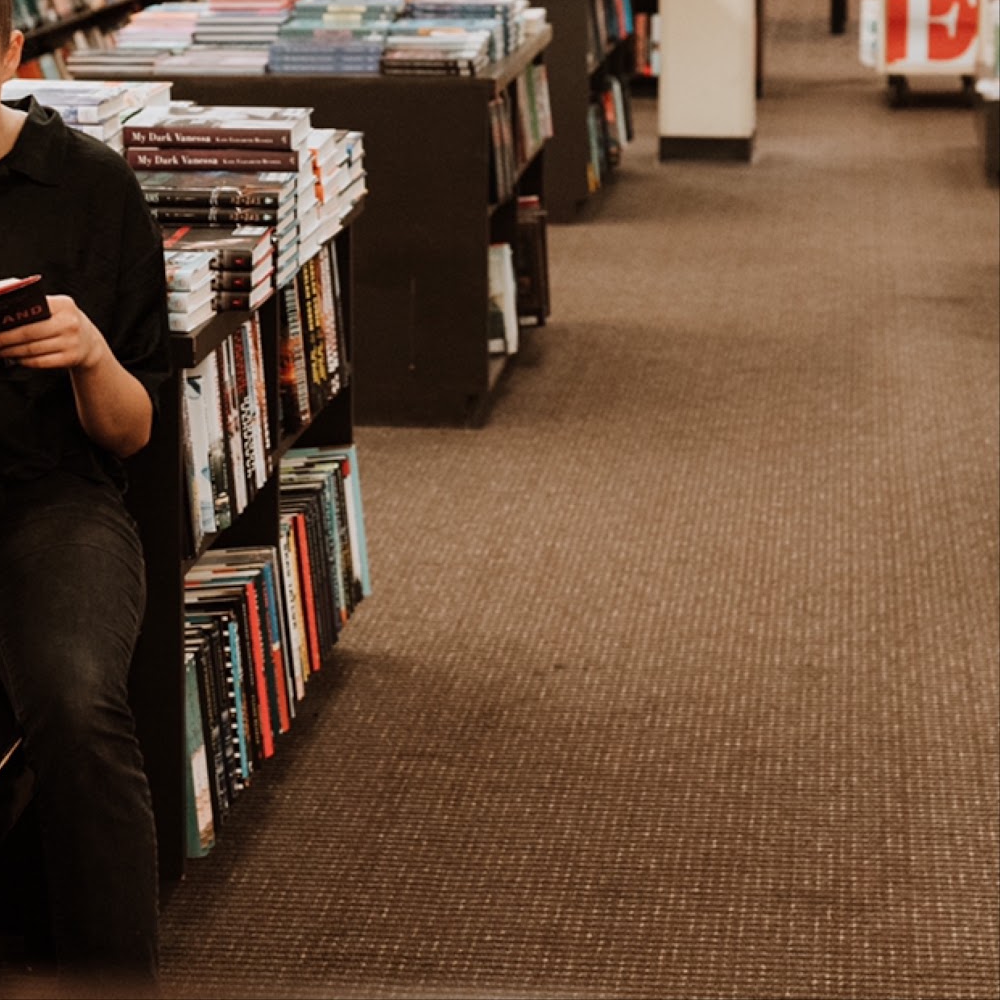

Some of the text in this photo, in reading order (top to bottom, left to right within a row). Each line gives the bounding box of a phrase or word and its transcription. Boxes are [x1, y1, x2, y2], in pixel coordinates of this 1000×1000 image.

[132, 132, 146, 143] My
[149, 132, 173, 142] Dark
[175, 133, 212, 143] Vanessa
[137, 155, 151, 167] My
[155, 155, 179, 165] Dark
[181, 155, 219, 166] Vanessa
